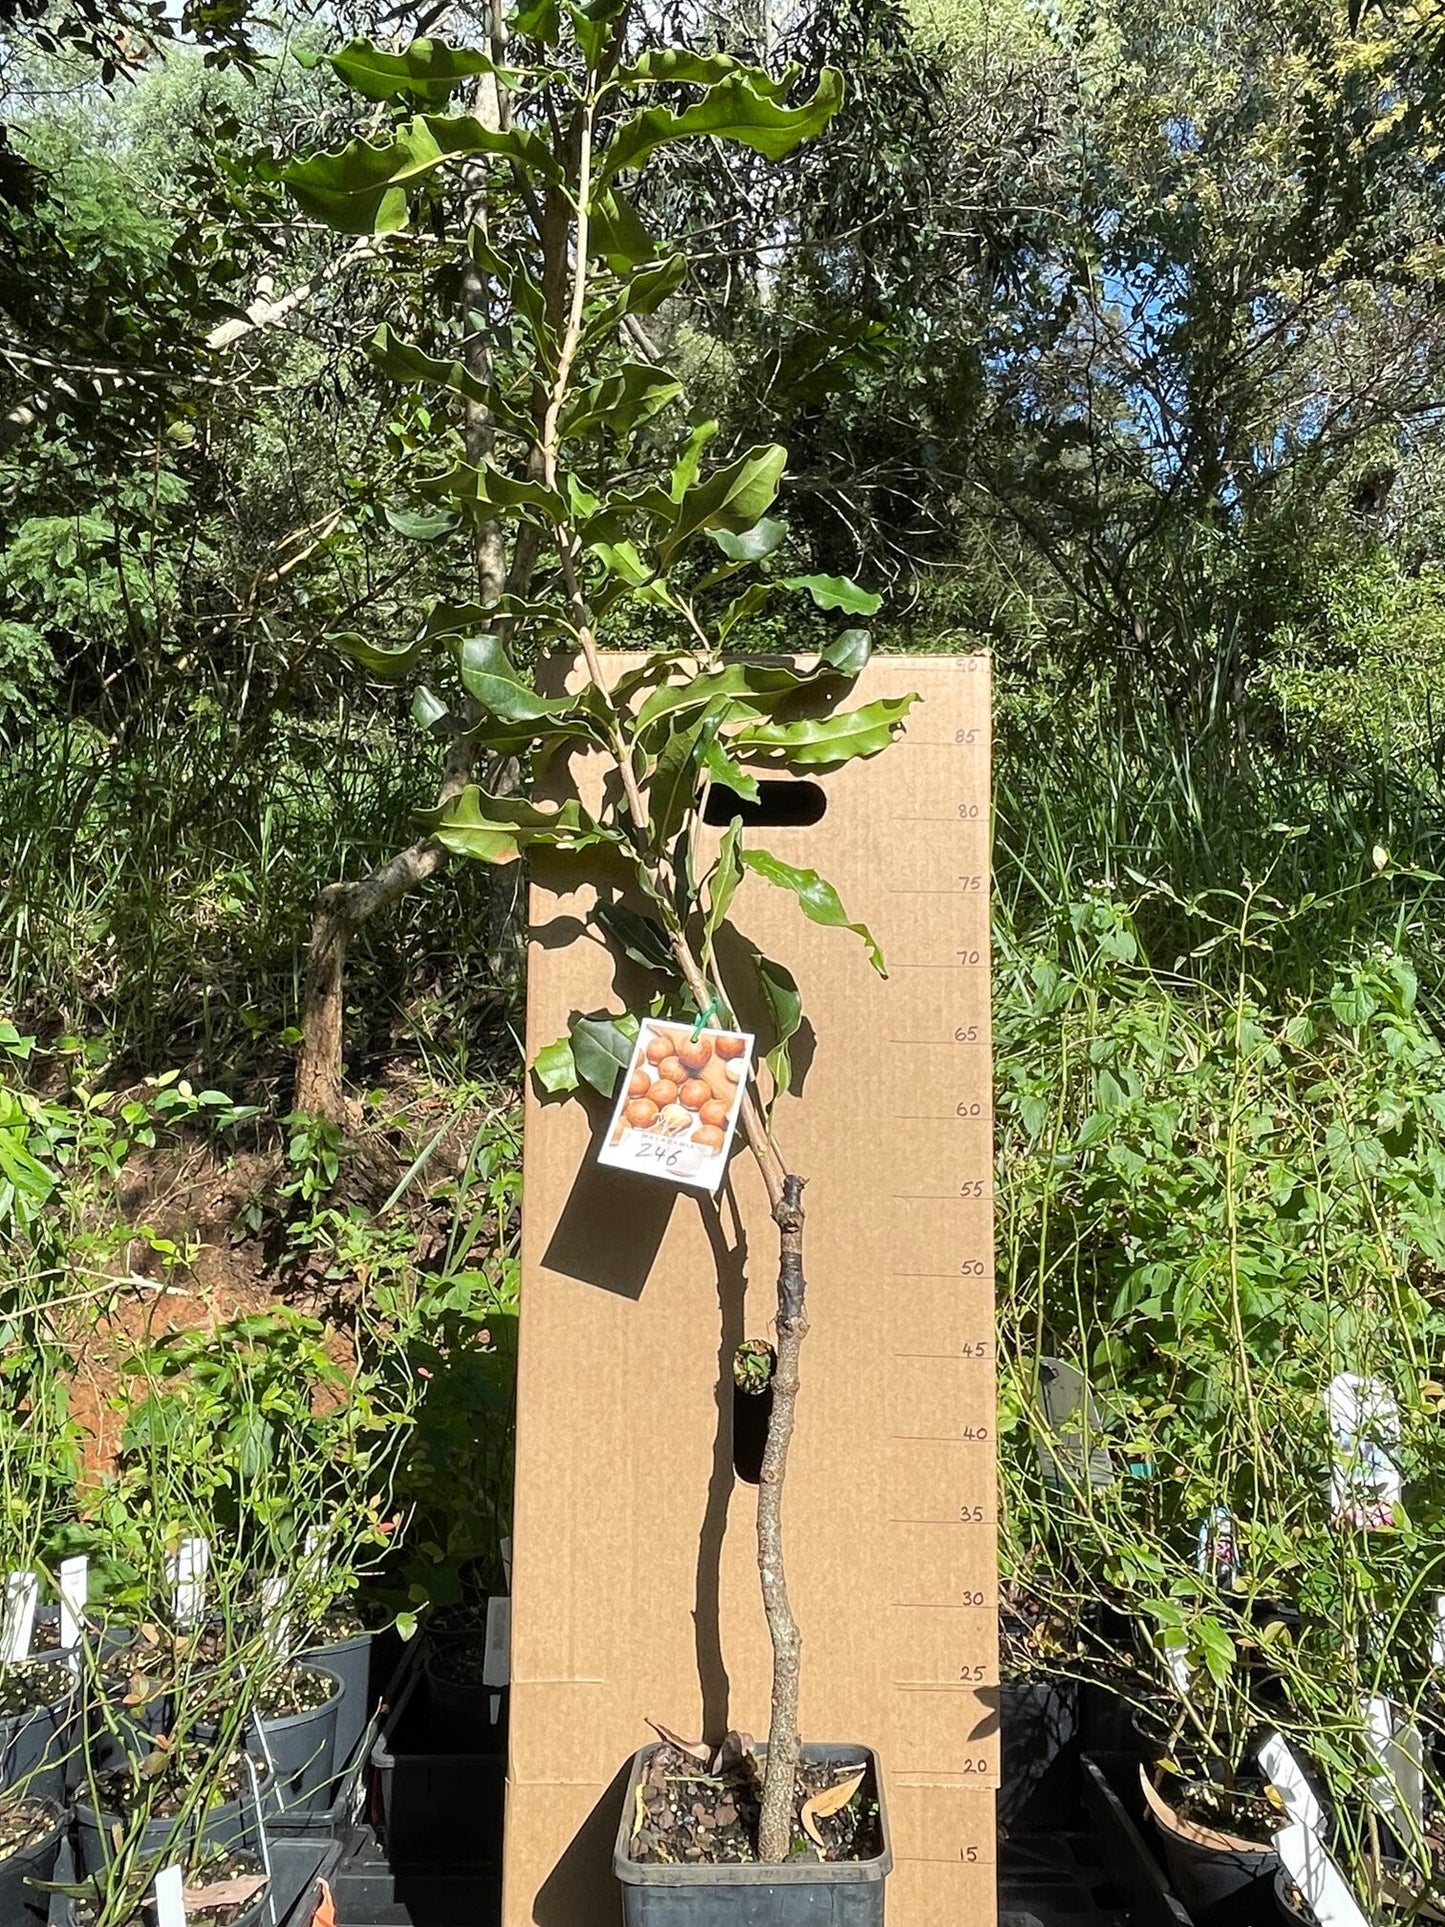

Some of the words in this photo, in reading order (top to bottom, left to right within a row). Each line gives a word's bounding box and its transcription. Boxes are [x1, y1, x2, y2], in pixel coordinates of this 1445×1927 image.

[955, 729, 980, 743] 85
[958, 804, 979, 818] 80
[958, 876, 981, 891] 75
[957, 951, 980, 965] 70
[955, 1026, 978, 1041] 65
[956, 1102, 980, 1116] 60
[635, 1142, 683, 1167] 246
[960, 1181, 984, 1197] 55
[960, 1260, 984, 1275] 50
[962, 1342, 988, 1357] 45
[963, 1427, 987, 1440] 40
[960, 1507, 983, 1522] 35
[962, 1592, 984, 1606] 30
[960, 1666, 986, 1680] 25
[963, 1759, 987, 1773] 20
[960, 1847, 978, 1861] 15
